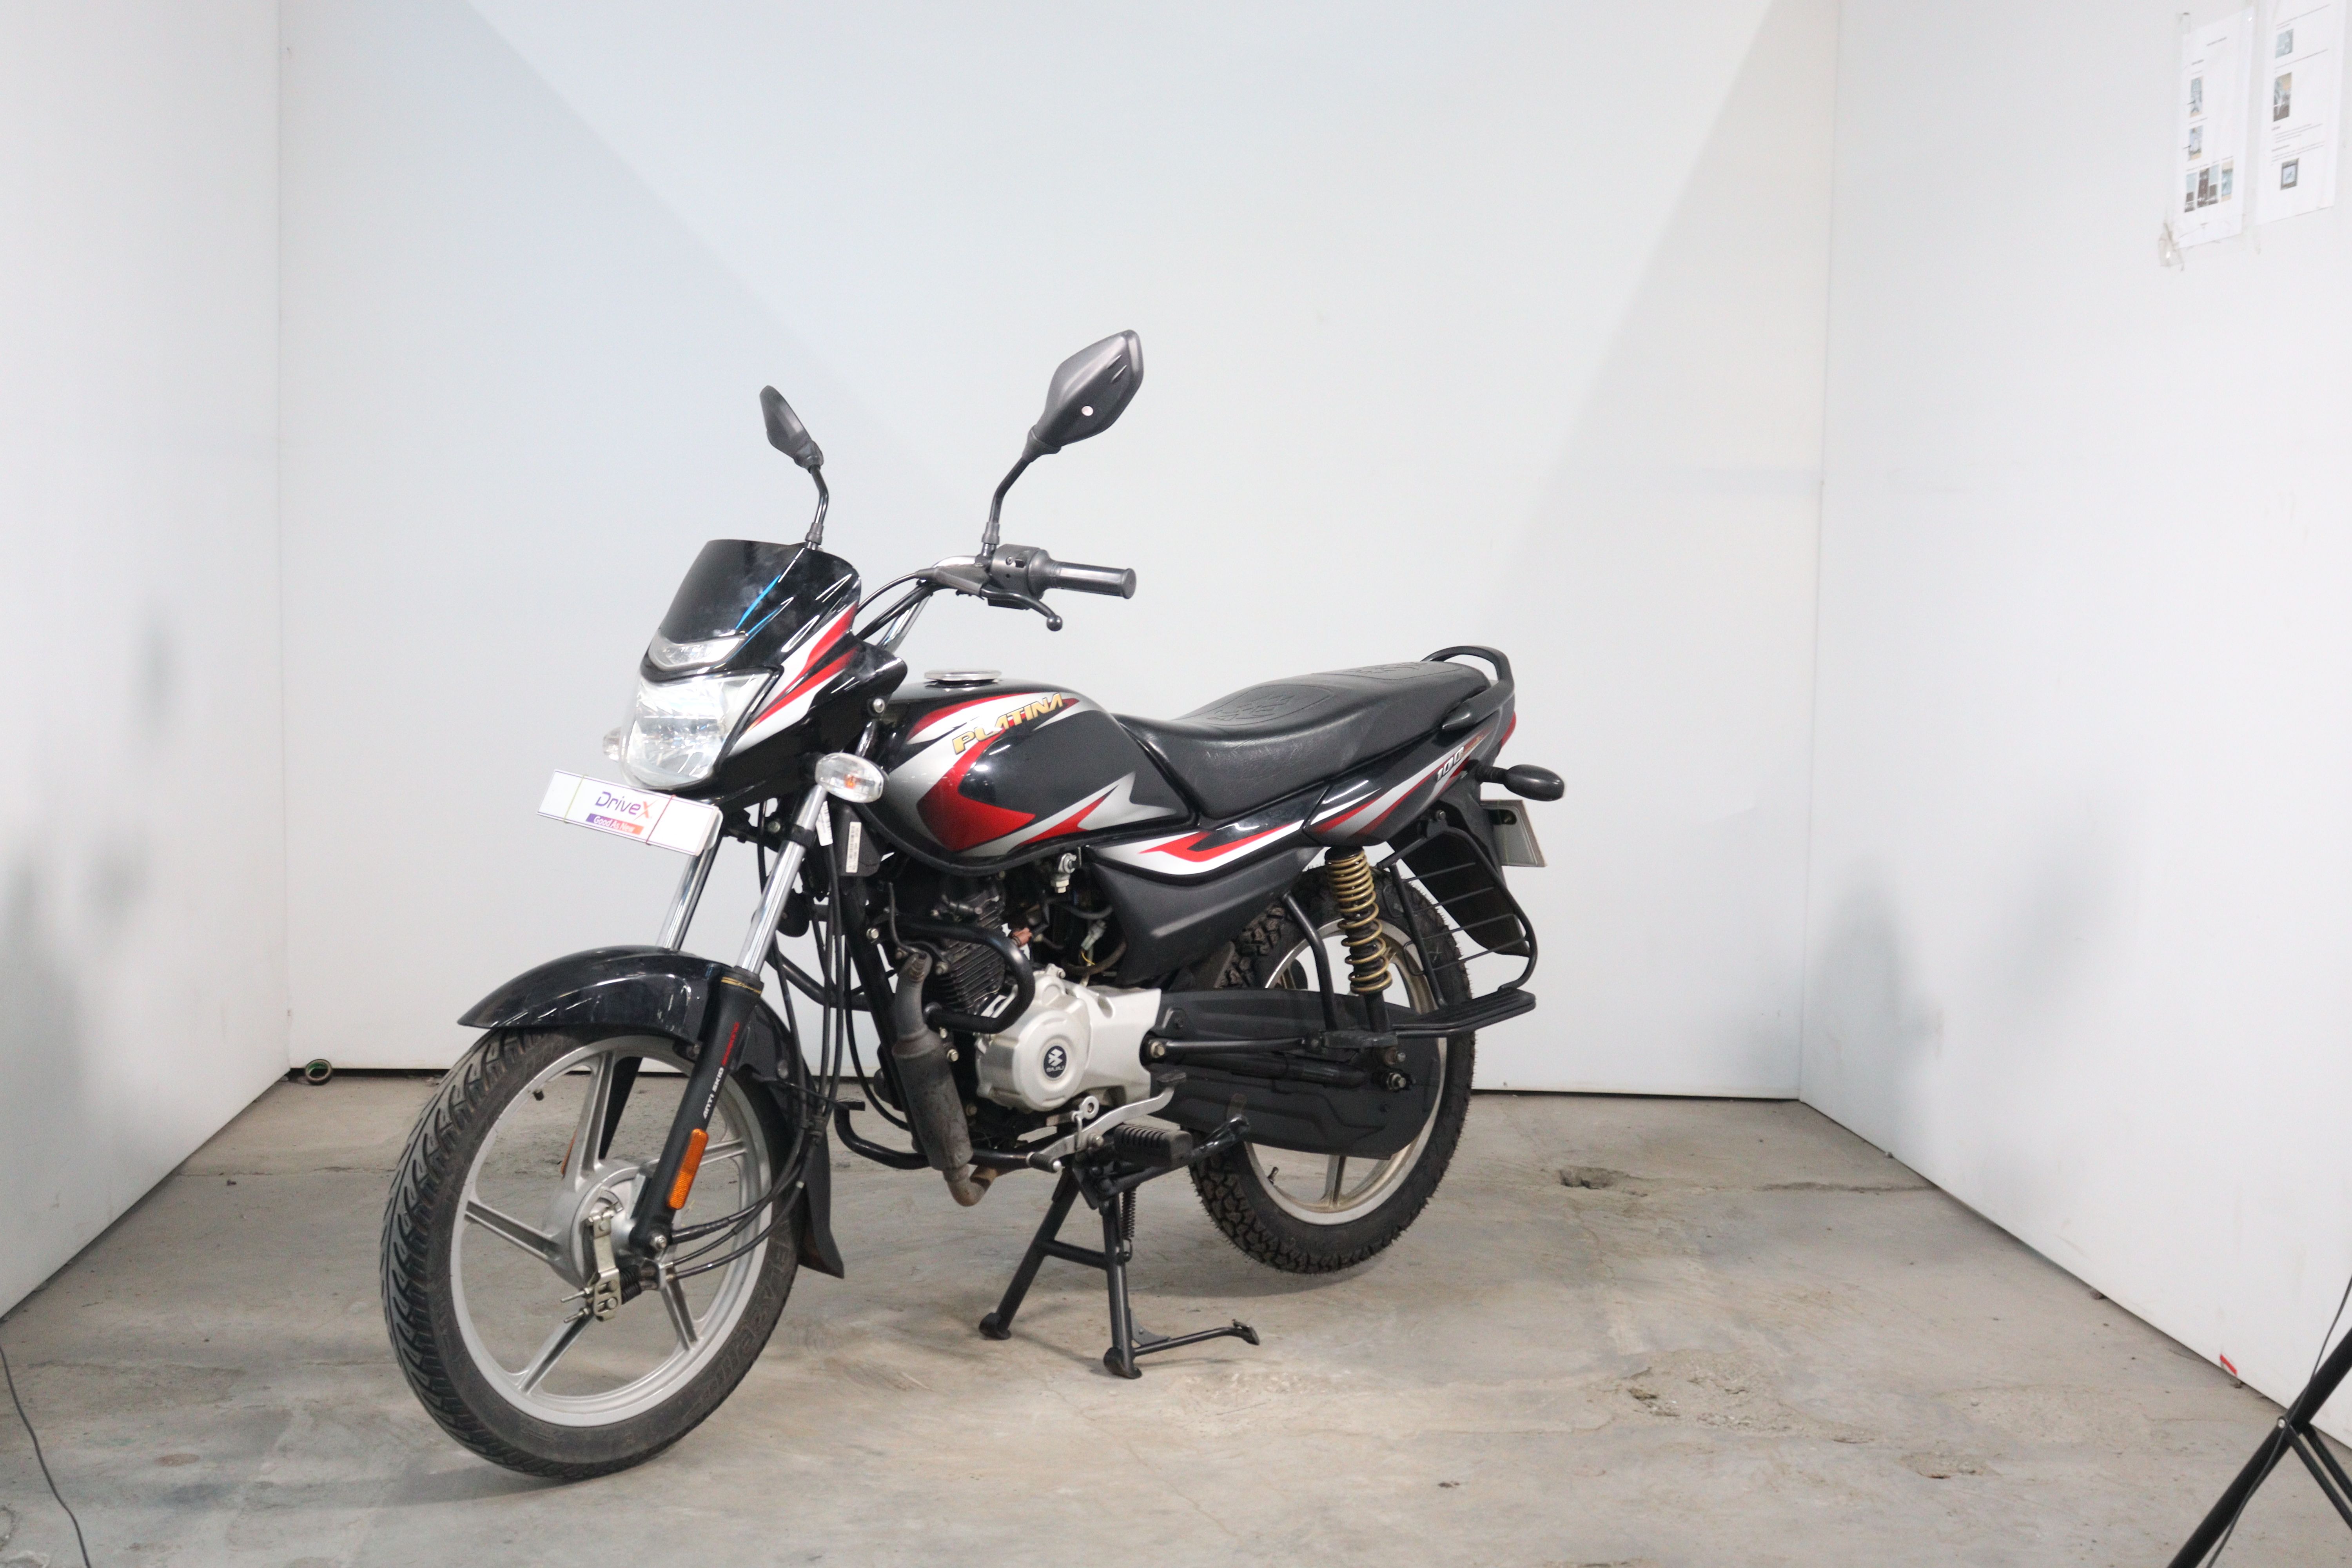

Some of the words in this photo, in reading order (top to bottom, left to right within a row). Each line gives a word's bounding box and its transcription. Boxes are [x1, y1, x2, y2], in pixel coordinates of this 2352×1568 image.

[952, 693, 1063, 755] PLATINA
[1437, 746, 1464, 781] 100
[595, 791, 659, 821] DriveX
[593, 816, 613, 828] Good
[610, 820, 621, 831] As
[619, 823, 635, 833] New
[703, 1093, 715, 1119] ANTI
[712, 1067, 724, 1092] SKID
